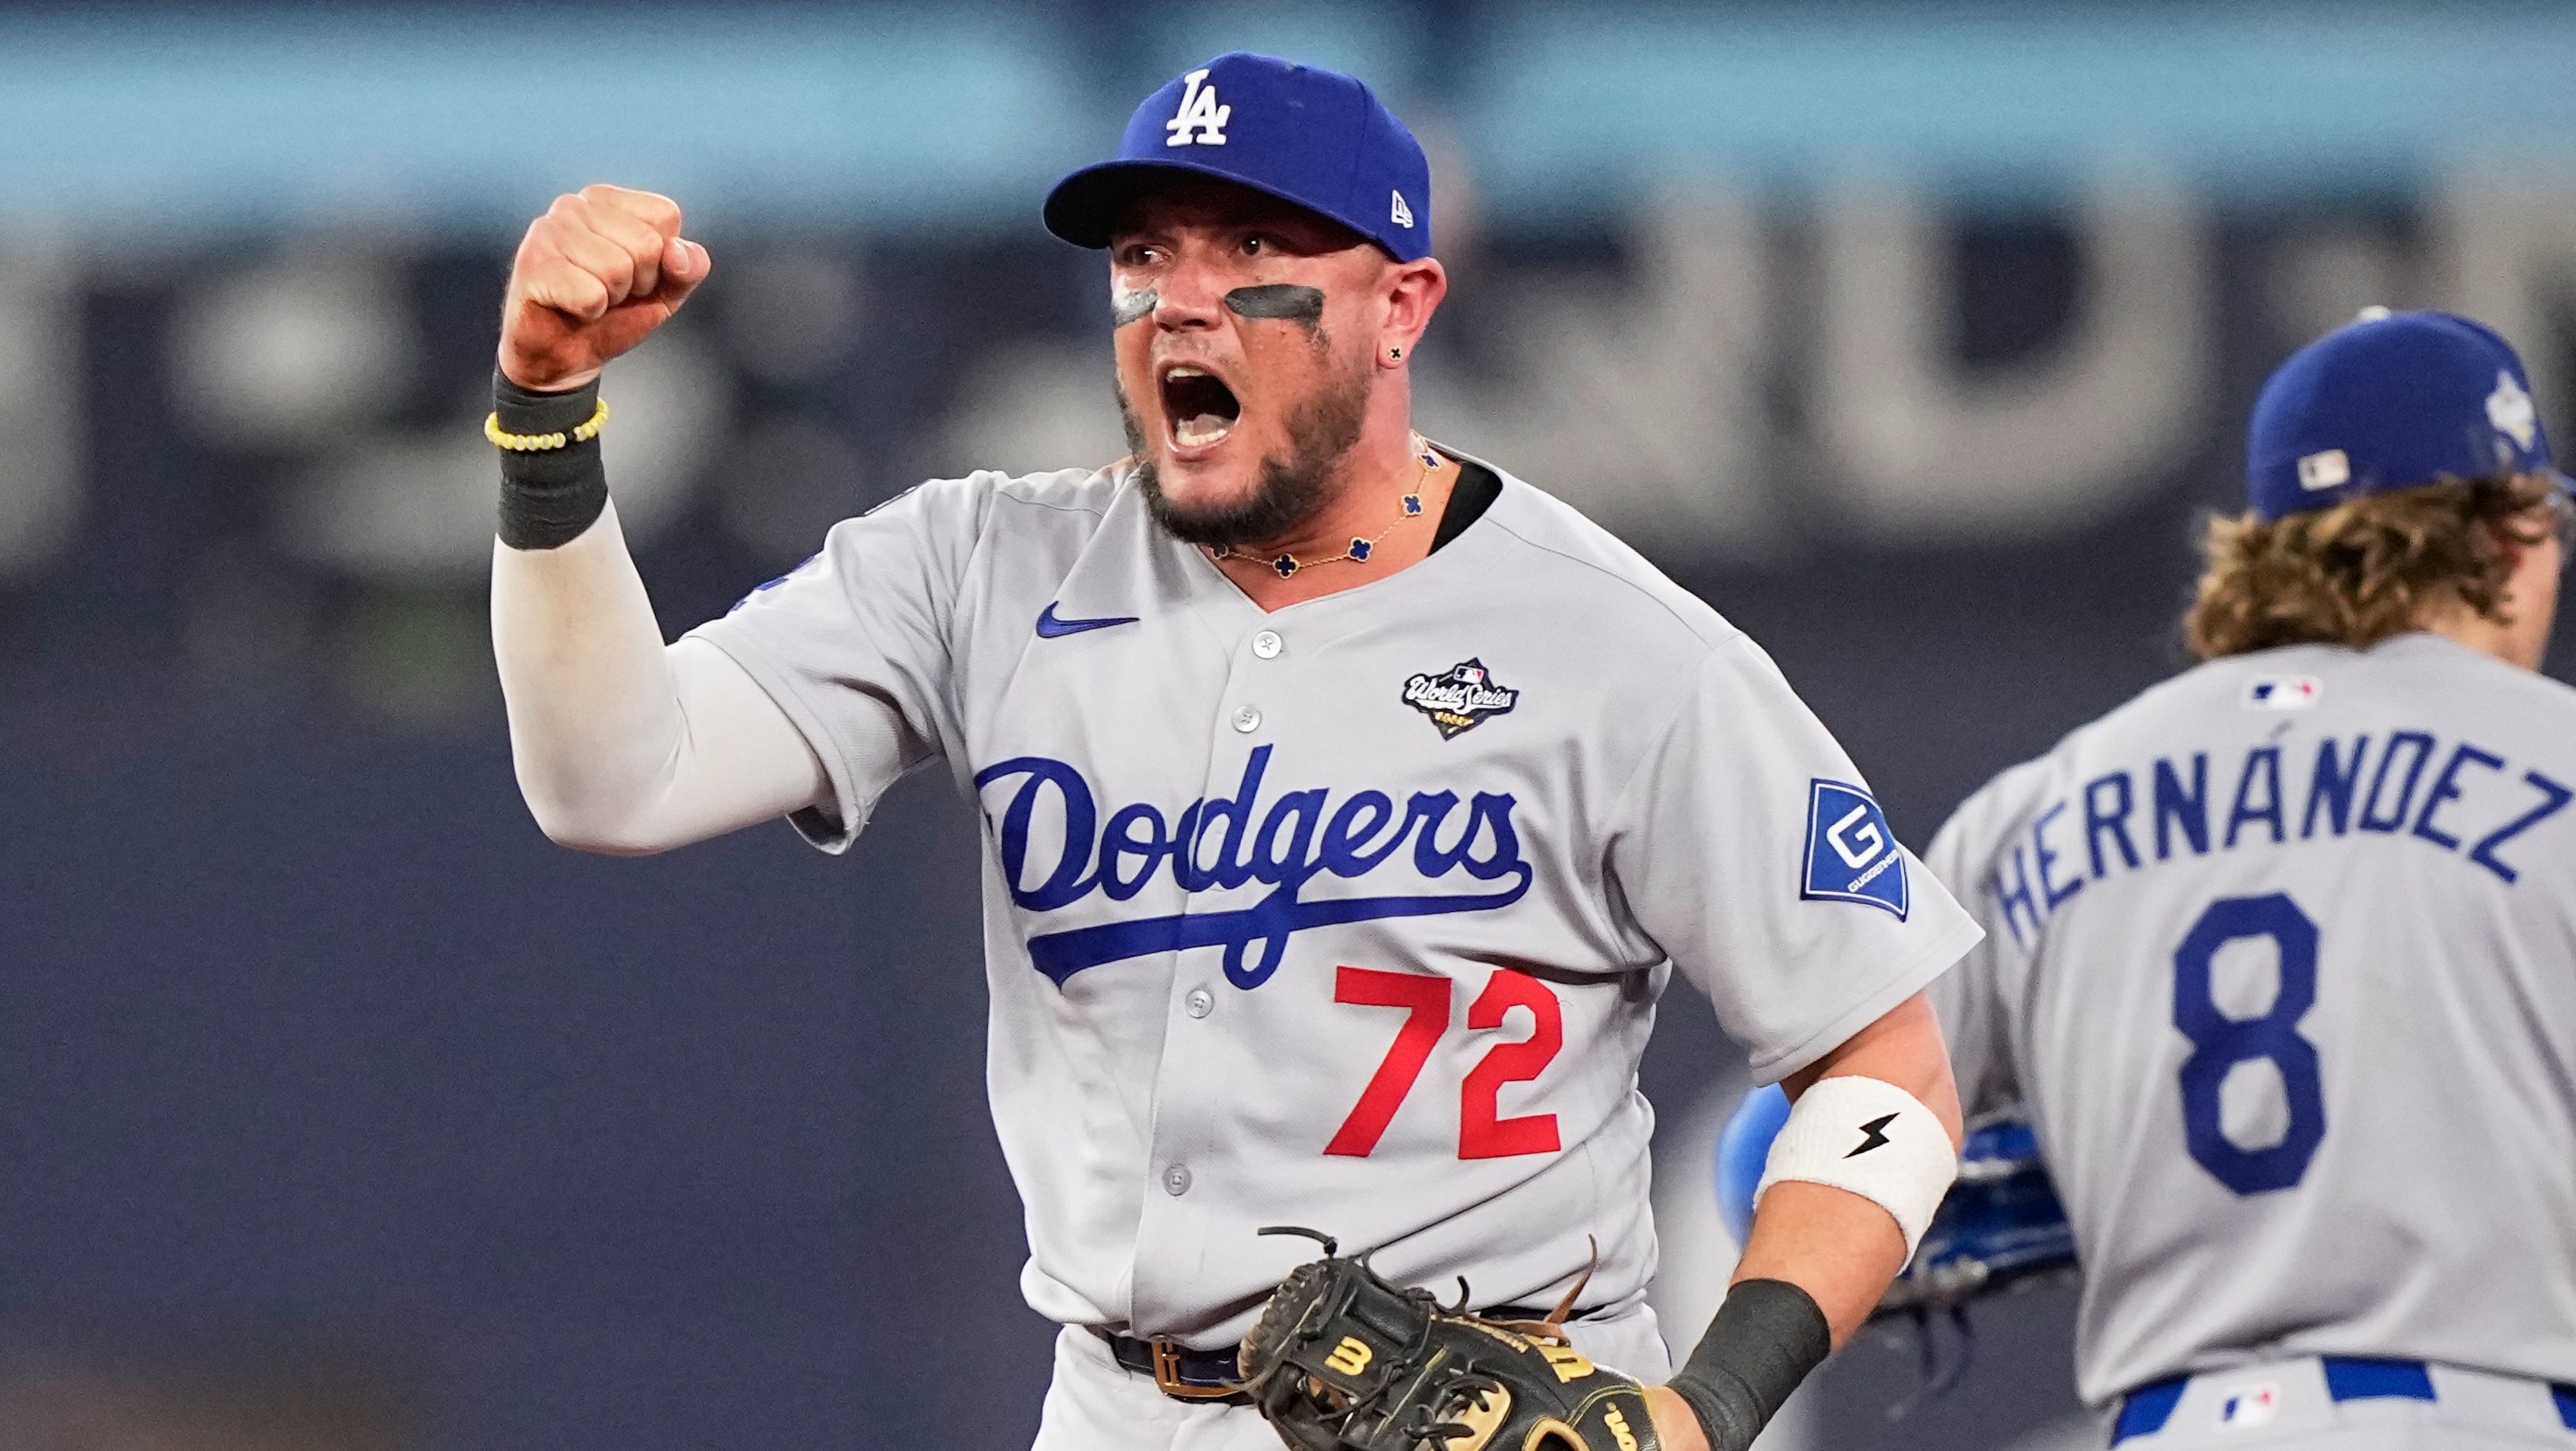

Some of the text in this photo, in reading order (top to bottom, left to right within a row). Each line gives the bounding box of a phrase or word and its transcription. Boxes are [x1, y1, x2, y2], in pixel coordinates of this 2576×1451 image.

[1166, 69, 1231, 146] LA
[1405, 675, 1512, 714] World Series
[975, 744, 1533, 996] Dodgers
[1827, 804, 1884, 869] G
[1993, 720, 2574, 948] HERNÁNDEZ
[1323, 965, 1563, 1159] 72
[2172, 892, 2326, 1197] 8
